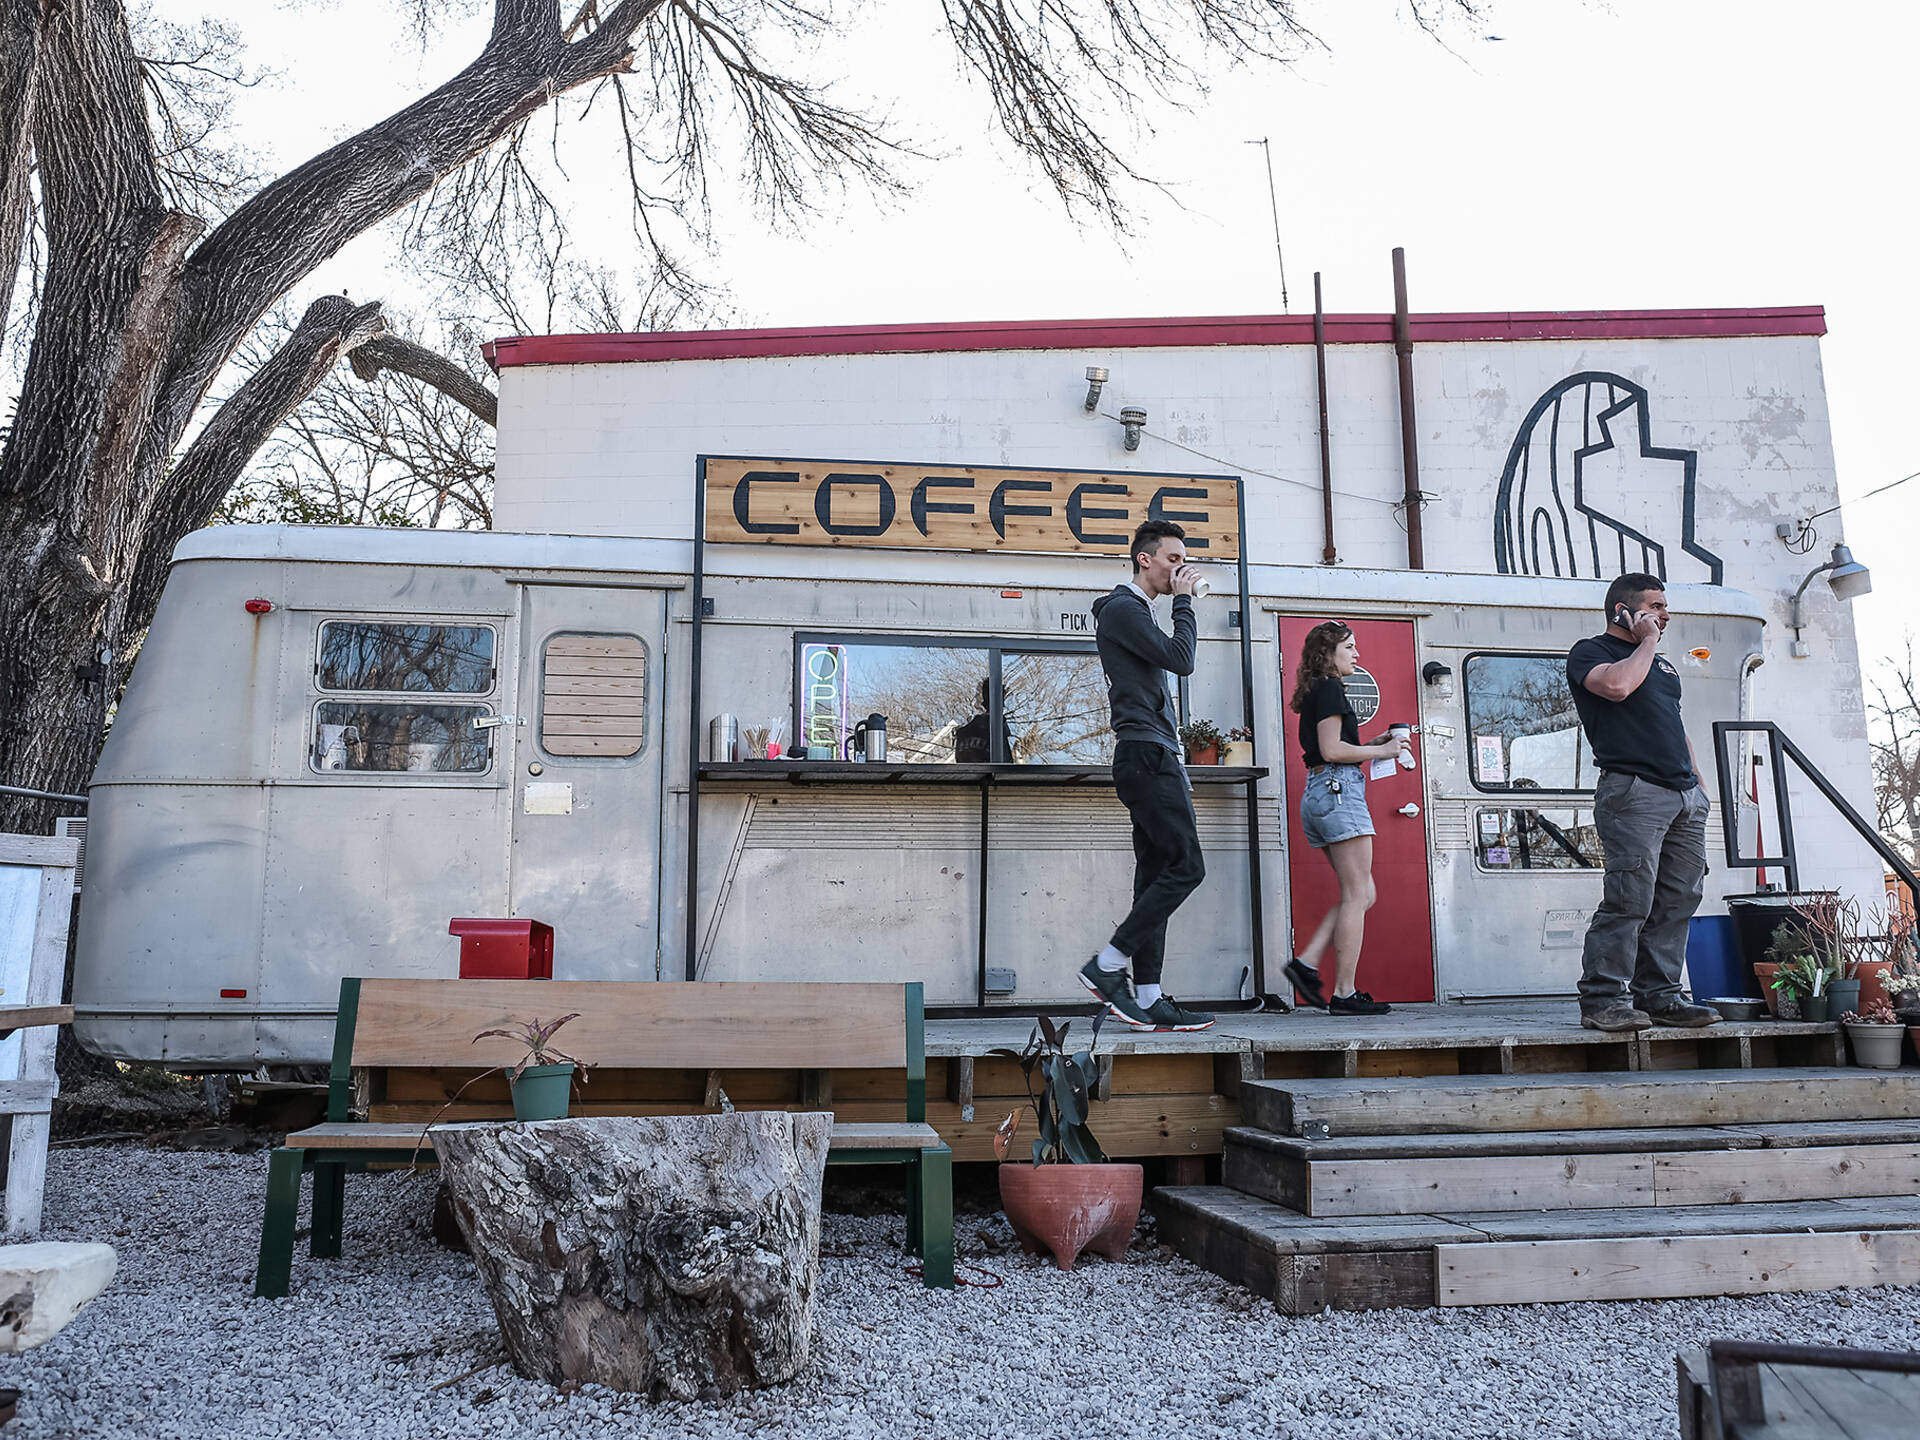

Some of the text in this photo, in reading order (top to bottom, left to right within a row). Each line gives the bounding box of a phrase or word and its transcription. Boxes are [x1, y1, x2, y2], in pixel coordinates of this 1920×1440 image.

[733, 472, 1208, 548] COFFEE
[1061, 613, 1087, 630] PICK
[808, 651, 838, 760] OPE
[1550, 911, 1586, 921] SPARTAN
